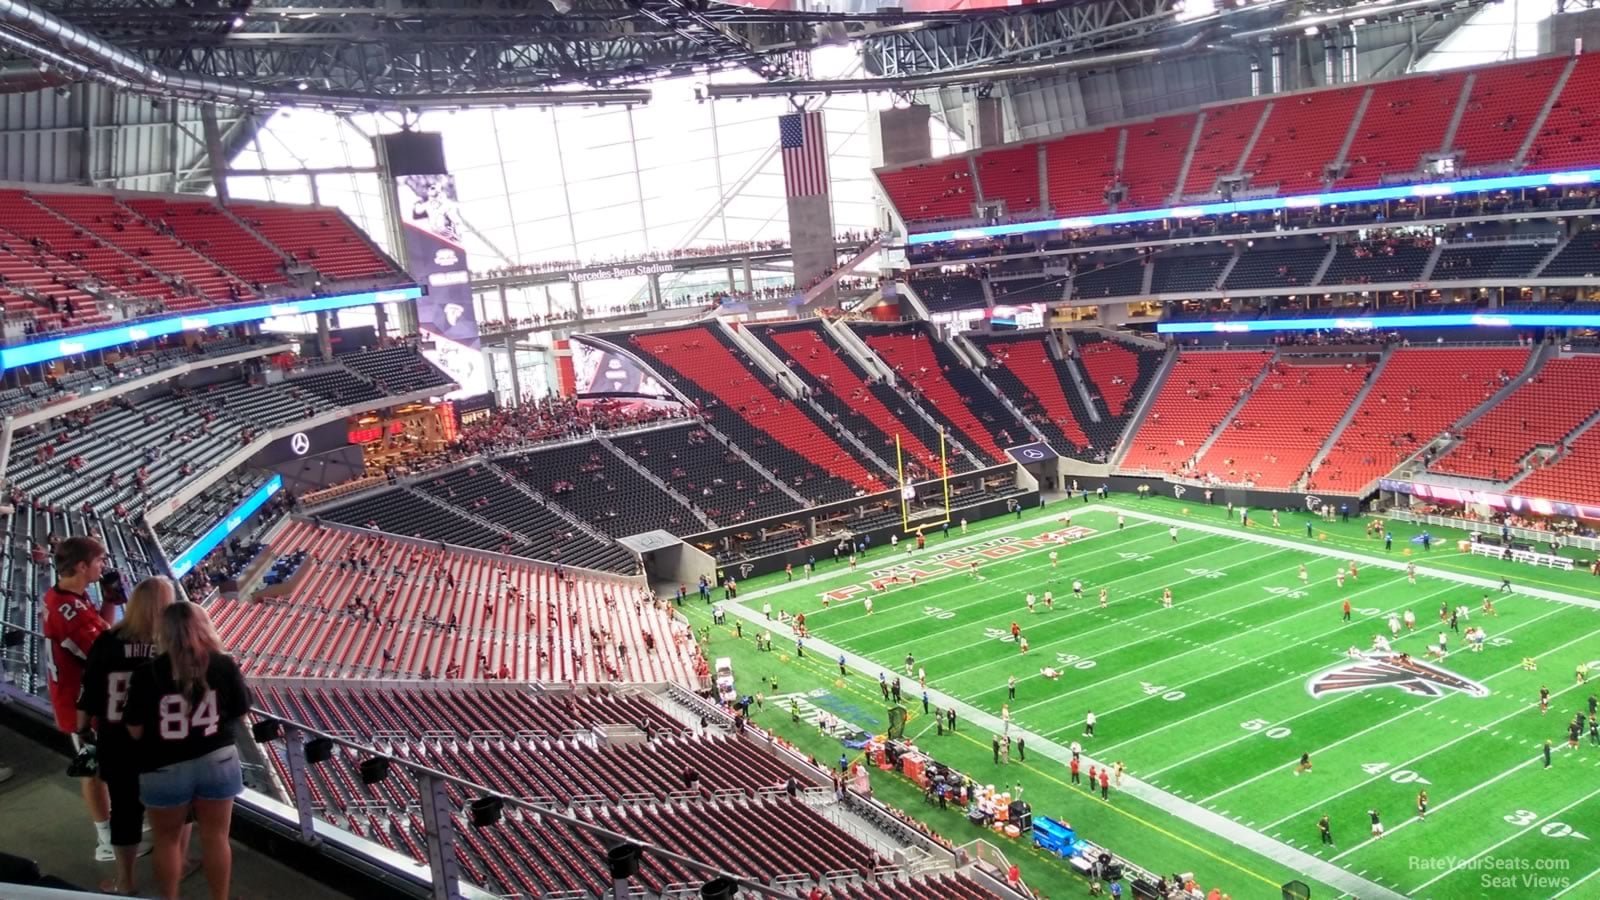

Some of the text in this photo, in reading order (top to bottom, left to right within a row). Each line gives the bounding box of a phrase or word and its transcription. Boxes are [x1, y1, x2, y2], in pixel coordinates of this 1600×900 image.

[568, 263, 673, 282] Mercedes-Benz Stadium
[866, 536, 1022, 577] ATLANTA
[58, 598, 89, 621] 24
[124, 643, 156, 659] WHITE
[107, 672, 134, 722] 8
[159, 690, 221, 740] 84
[1240, 718, 1292, 739] 50
[1361, 762, 1419, 784] 40
[1503, 809, 1573, 838] 30
